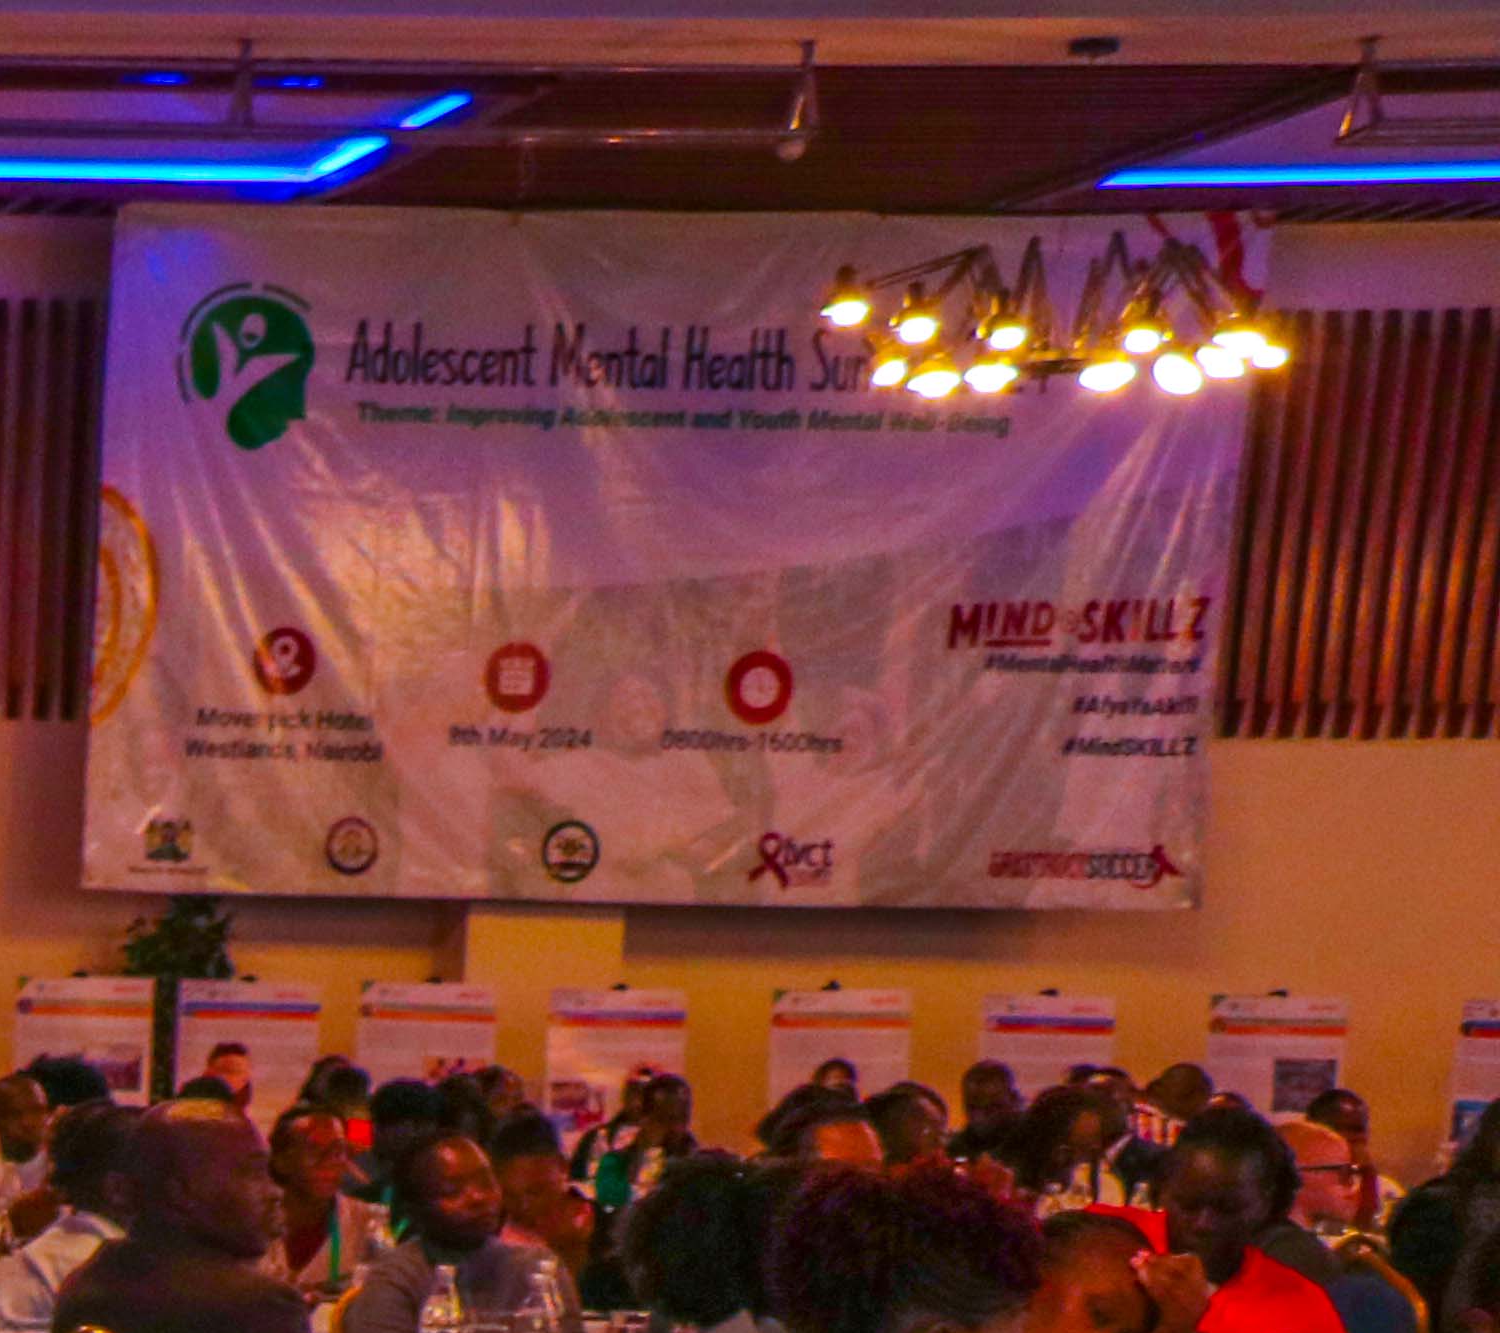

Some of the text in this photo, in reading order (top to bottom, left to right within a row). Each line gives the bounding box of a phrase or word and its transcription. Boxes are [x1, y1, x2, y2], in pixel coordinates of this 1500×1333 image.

[345, 319, 538, 386] Adolescent
[550, 322, 669, 388] Mental
[685, 326, 796, 391] Health
[948, 597, 1210, 649] MIND SKILLZ
